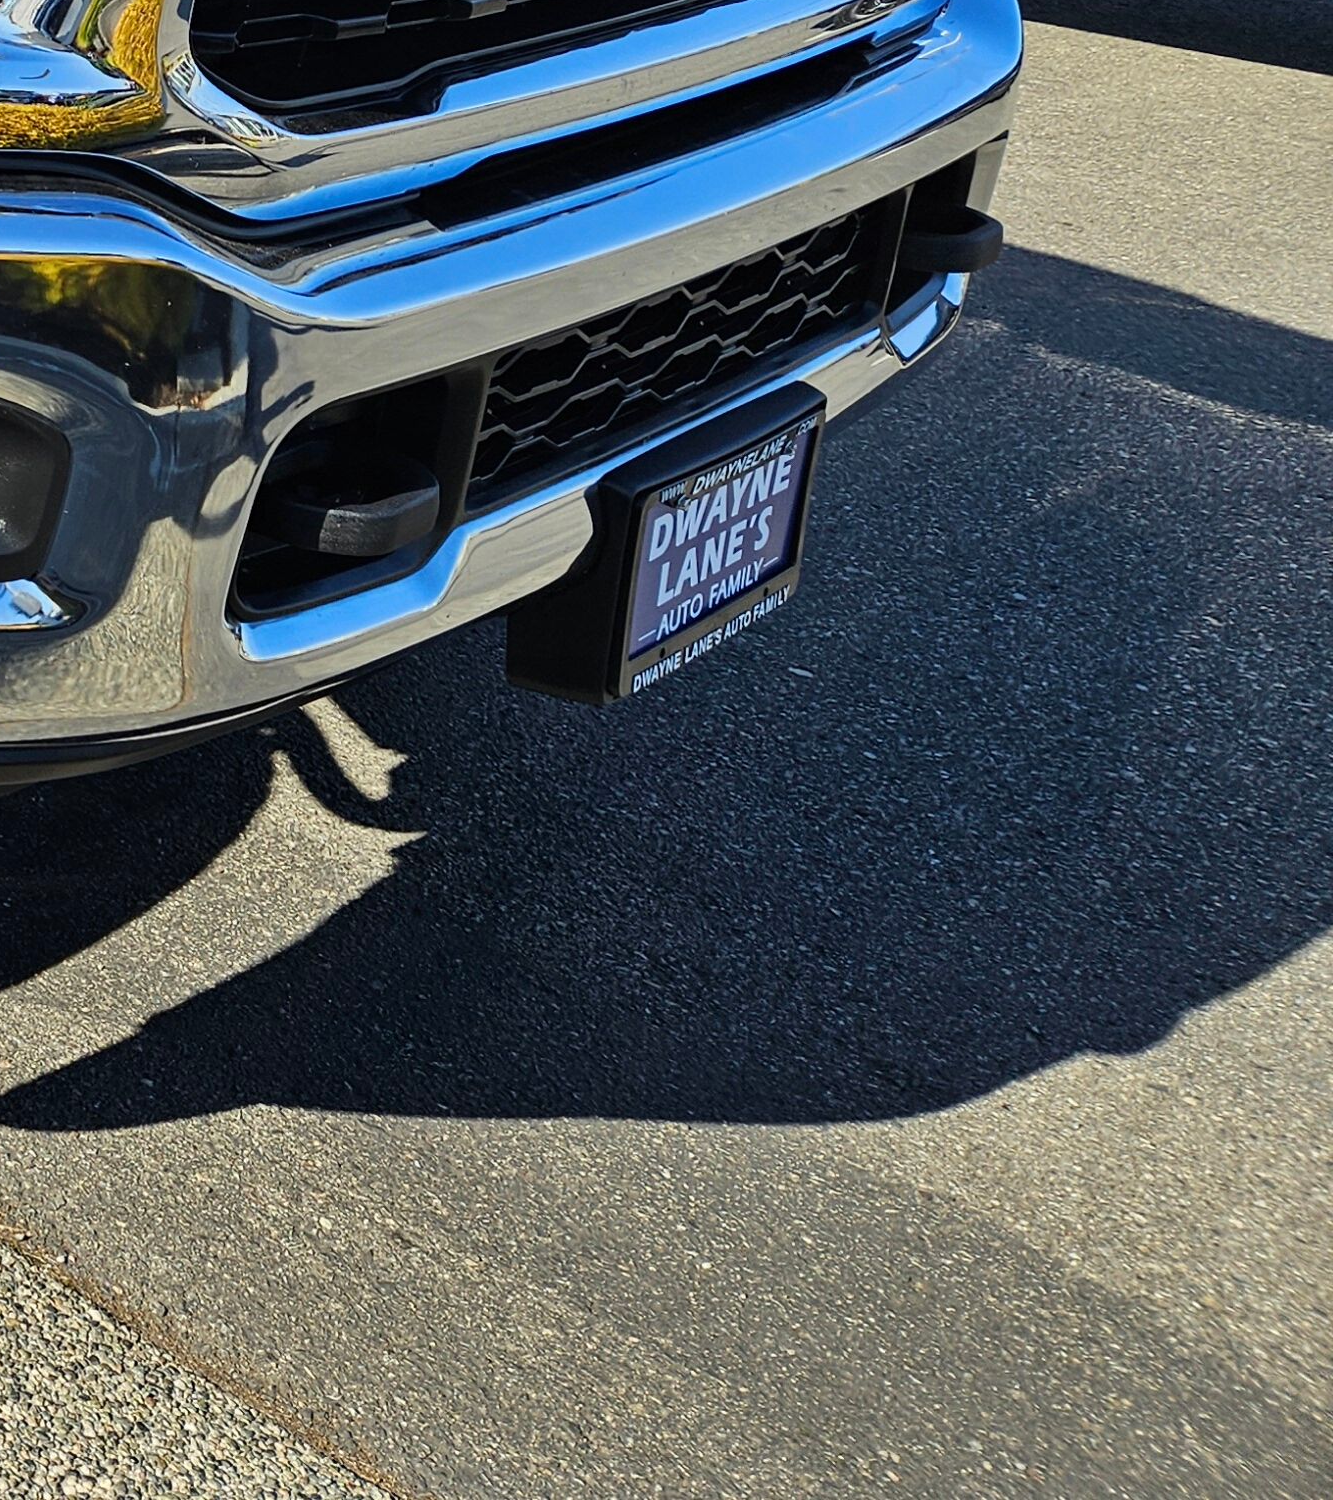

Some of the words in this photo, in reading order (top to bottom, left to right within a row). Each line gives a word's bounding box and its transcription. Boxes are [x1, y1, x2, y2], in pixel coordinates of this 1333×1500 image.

[648, 454, 795, 562] DWAYNE
[656, 506, 773, 607] LANE'S
[632, 651, 682, 694] DWAYNE
[684, 628, 723, 664] LANE'S
[723, 610, 752, 641] AUTO
[752, 584, 791, 623] FAMILY
[655, 592, 704, 641] AUTO
[708, 557, 765, 609] FAMILY
